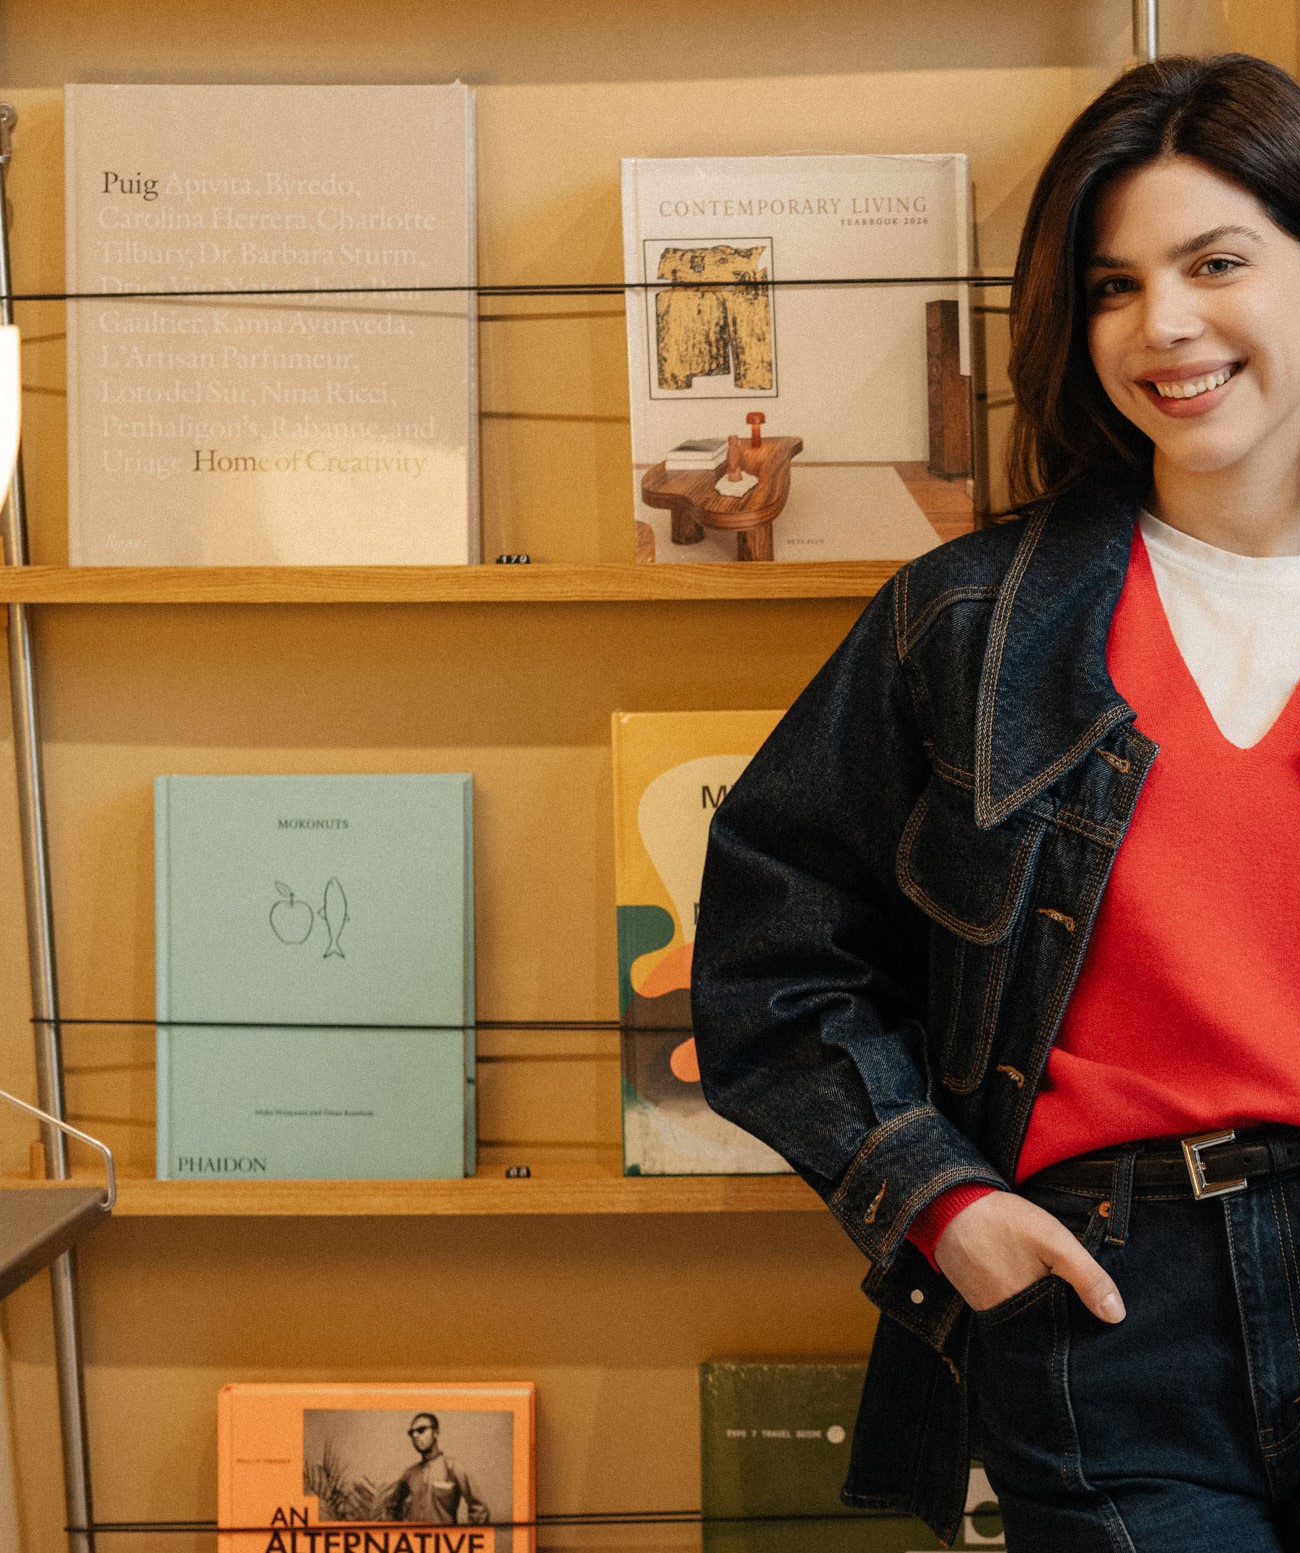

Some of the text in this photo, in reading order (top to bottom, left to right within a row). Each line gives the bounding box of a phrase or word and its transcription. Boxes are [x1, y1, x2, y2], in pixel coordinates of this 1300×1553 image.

[102, 170, 159, 201] Puig
[659, 196, 927, 217] CONTEMPORARY LIVING
[98, 205, 205, 230] Carolina
[318, 206, 436, 231] Charlotte
[840, 217, 898, 227] YEARBOOK
[240, 241, 334, 265] Barbara
[391, 415, 437, 439] and
[193, 448, 267, 474] Home
[274, 448, 305, 474] of
[305, 448, 428, 479] Creativity
[278, 818, 349, 830] MOKONUTS
[178, 1156, 267, 1174] PHAIDON
[271, 1506, 309, 1527] AN
